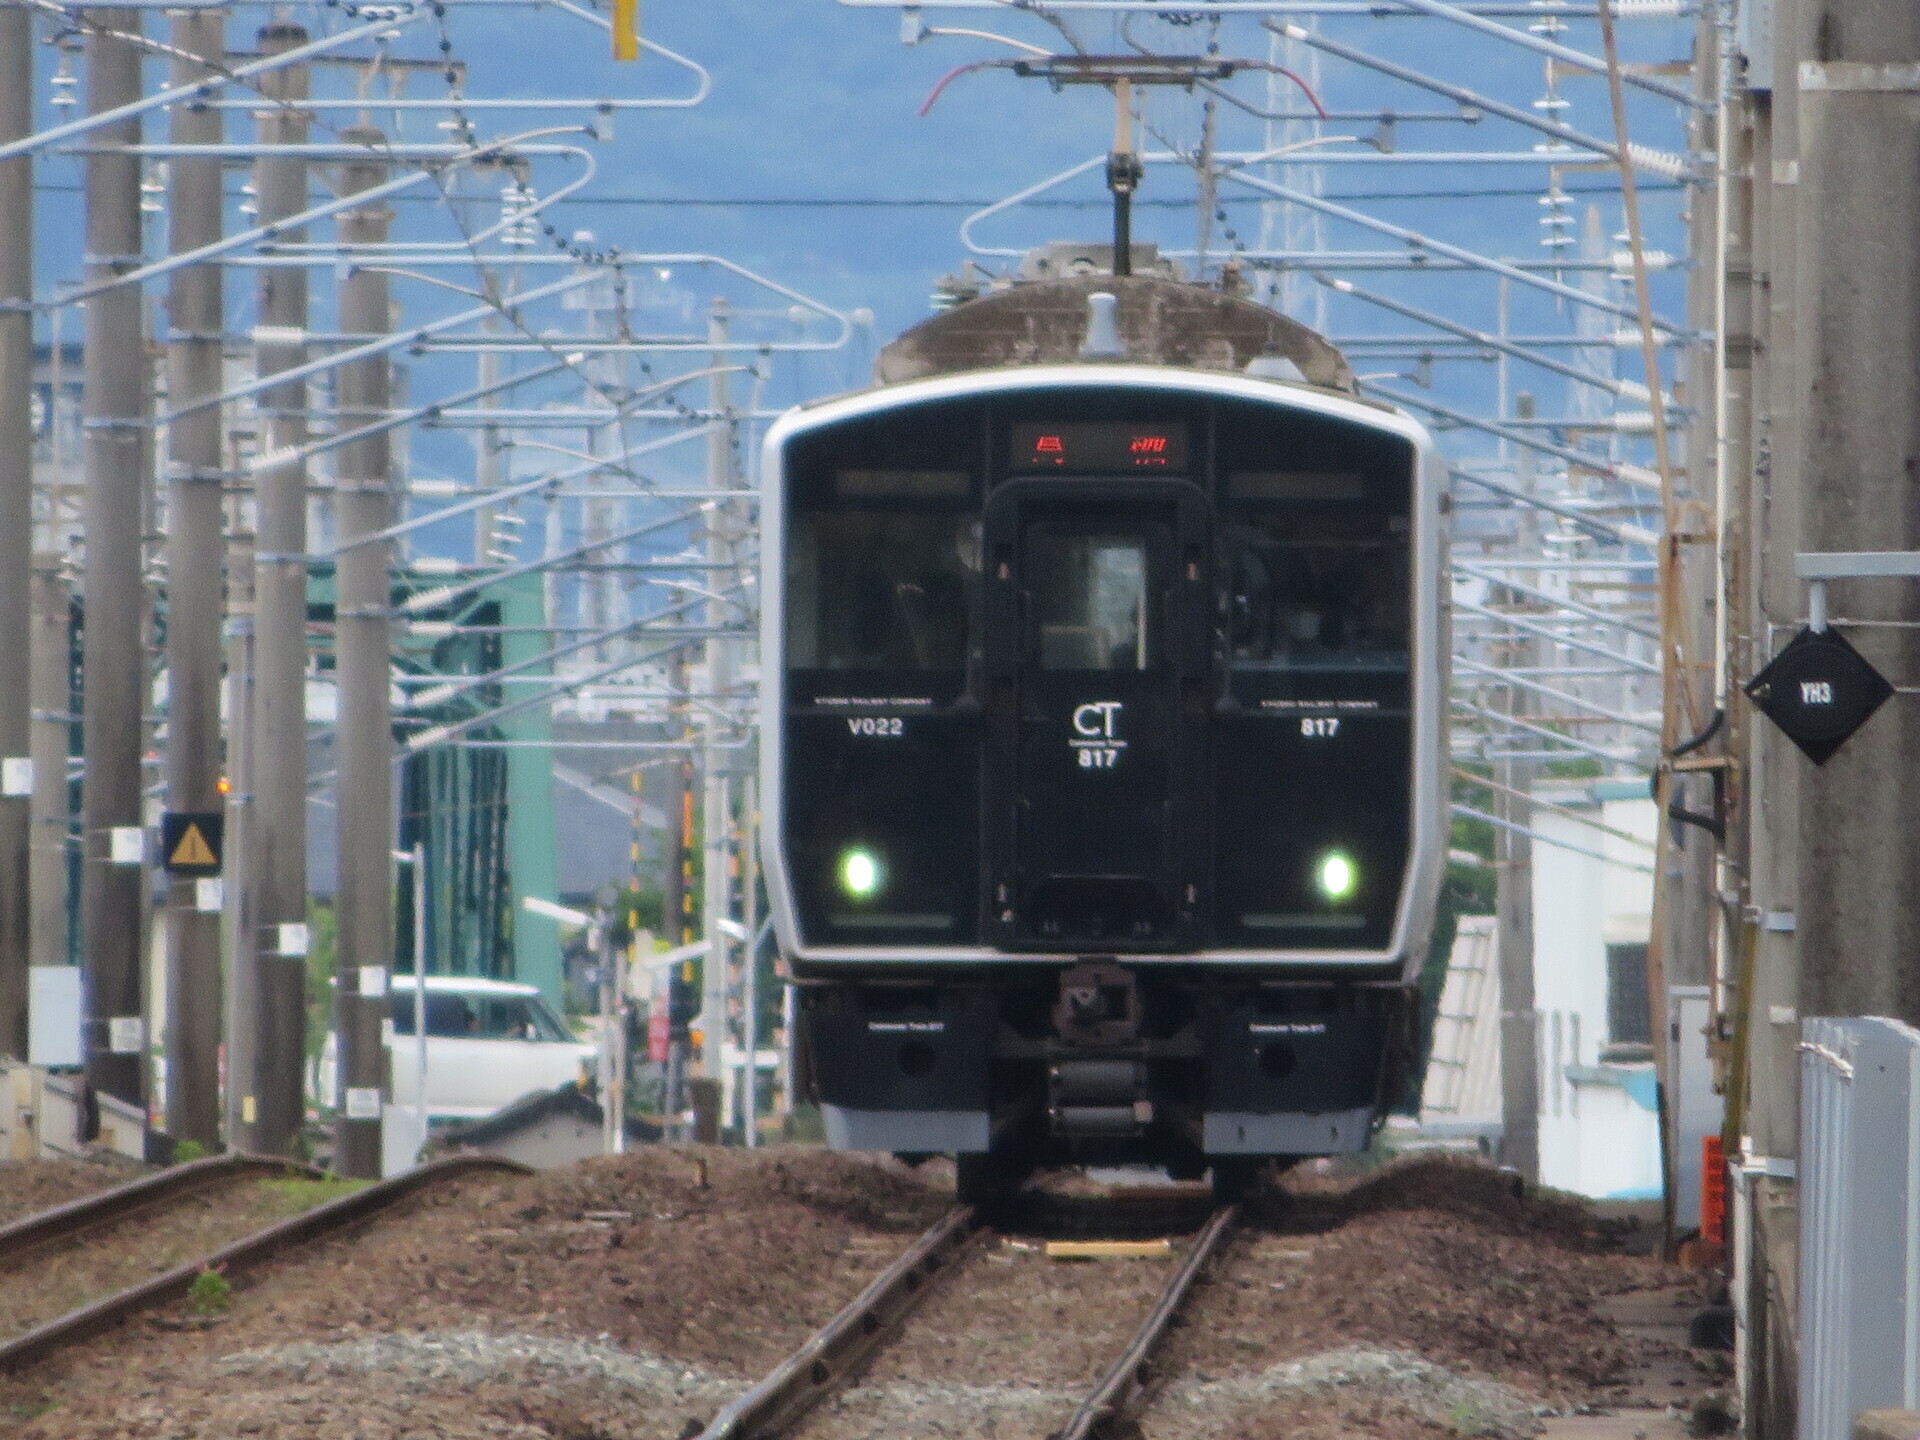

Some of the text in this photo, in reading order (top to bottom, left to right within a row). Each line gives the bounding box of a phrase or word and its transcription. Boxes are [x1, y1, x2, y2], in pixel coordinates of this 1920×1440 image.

[847, 718, 903, 735] V022
[1073, 701, 1122, 737] CT
[1300, 718, 1339, 736] 817
[1078, 749, 1117, 767] 817
